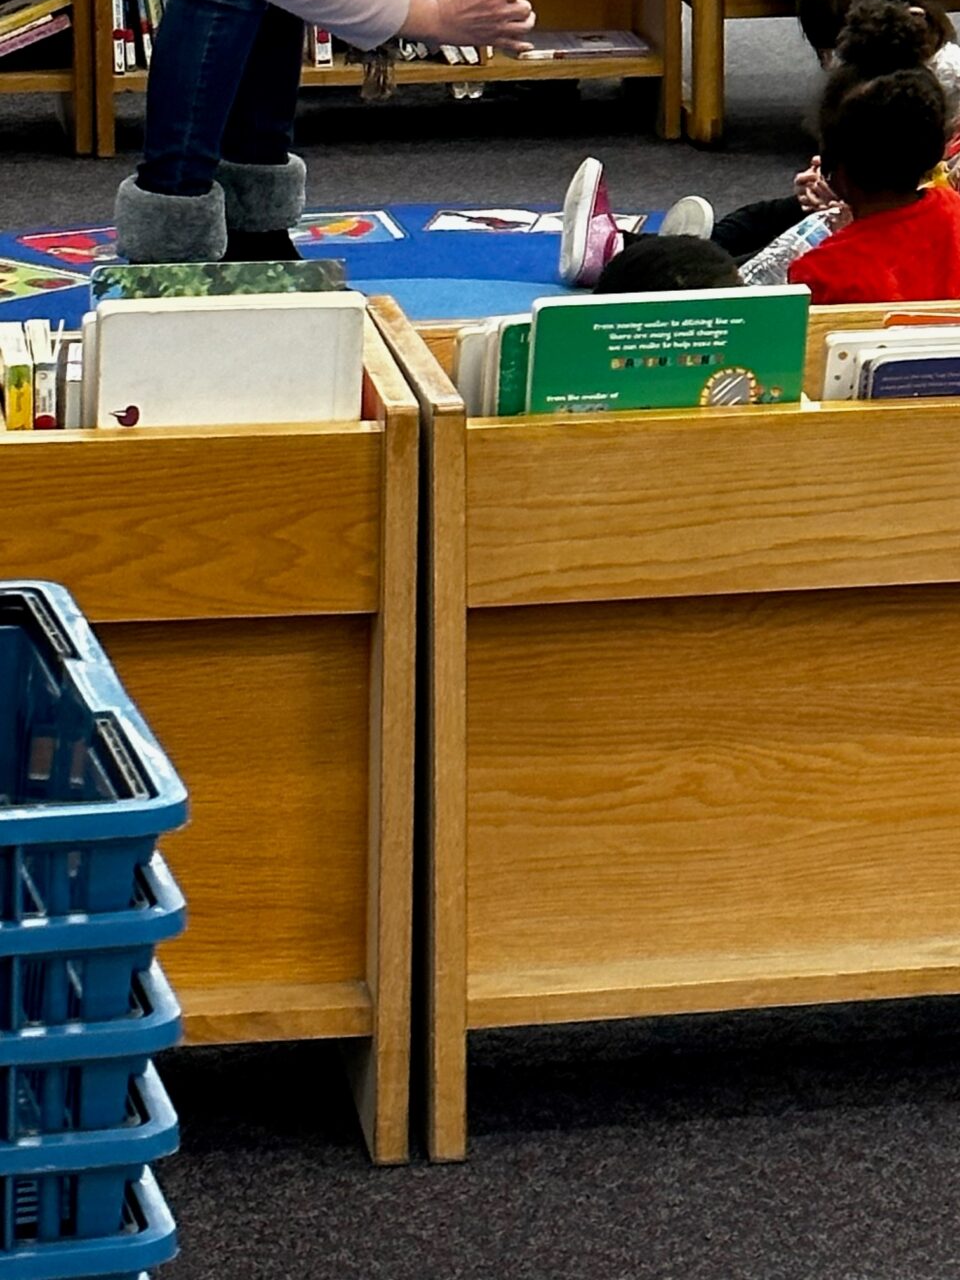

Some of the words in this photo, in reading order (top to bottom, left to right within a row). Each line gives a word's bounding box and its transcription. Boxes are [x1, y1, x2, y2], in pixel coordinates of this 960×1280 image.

[643, 320, 669, 328] water
[649, 332, 671, 341] many
[673, 329, 695, 337] small
[696, 329, 729, 339] changes
[638, 342, 660, 350] make
[662, 341, 672, 349] to
[673, 340, 692, 350] help
[609, 391, 620, 399] of
